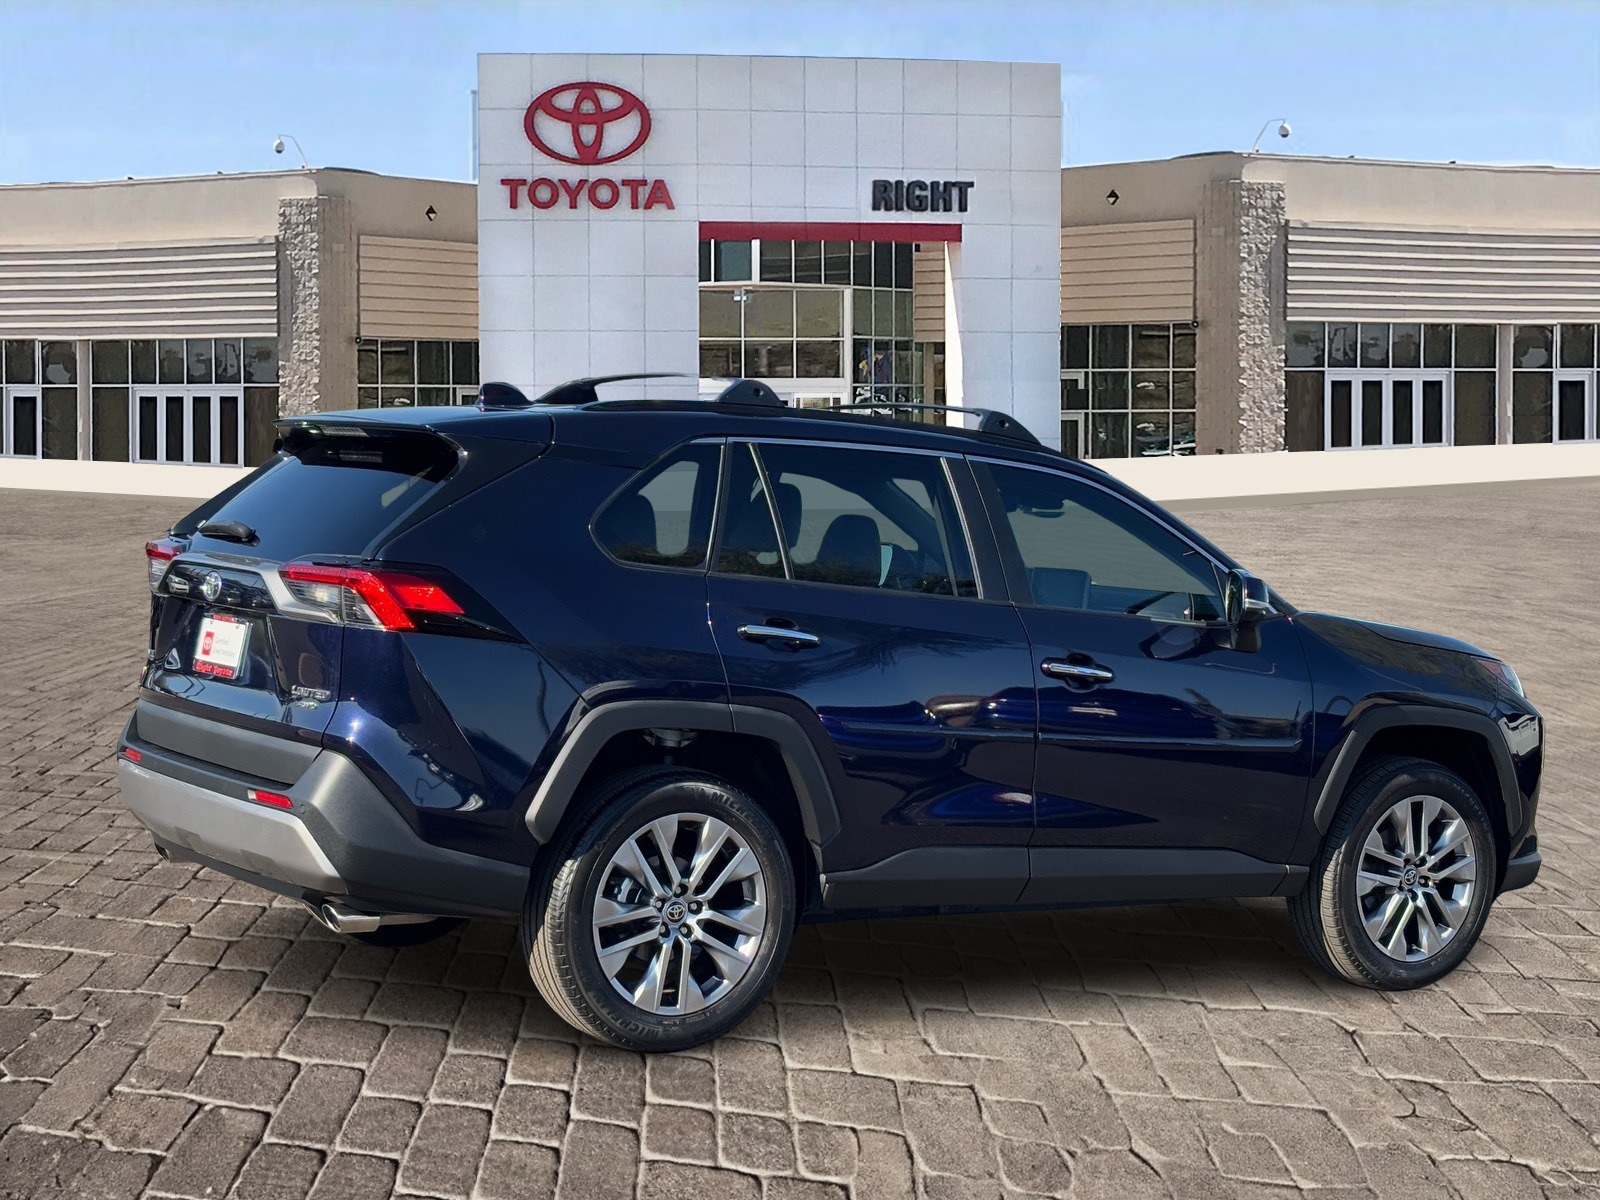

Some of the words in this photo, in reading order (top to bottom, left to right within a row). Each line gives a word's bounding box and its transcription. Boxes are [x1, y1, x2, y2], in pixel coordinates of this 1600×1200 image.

[500, 178, 675, 210] TOYOTA
[872, 179, 975, 212] RIGHT
[291, 684, 331, 700] LIMITED
